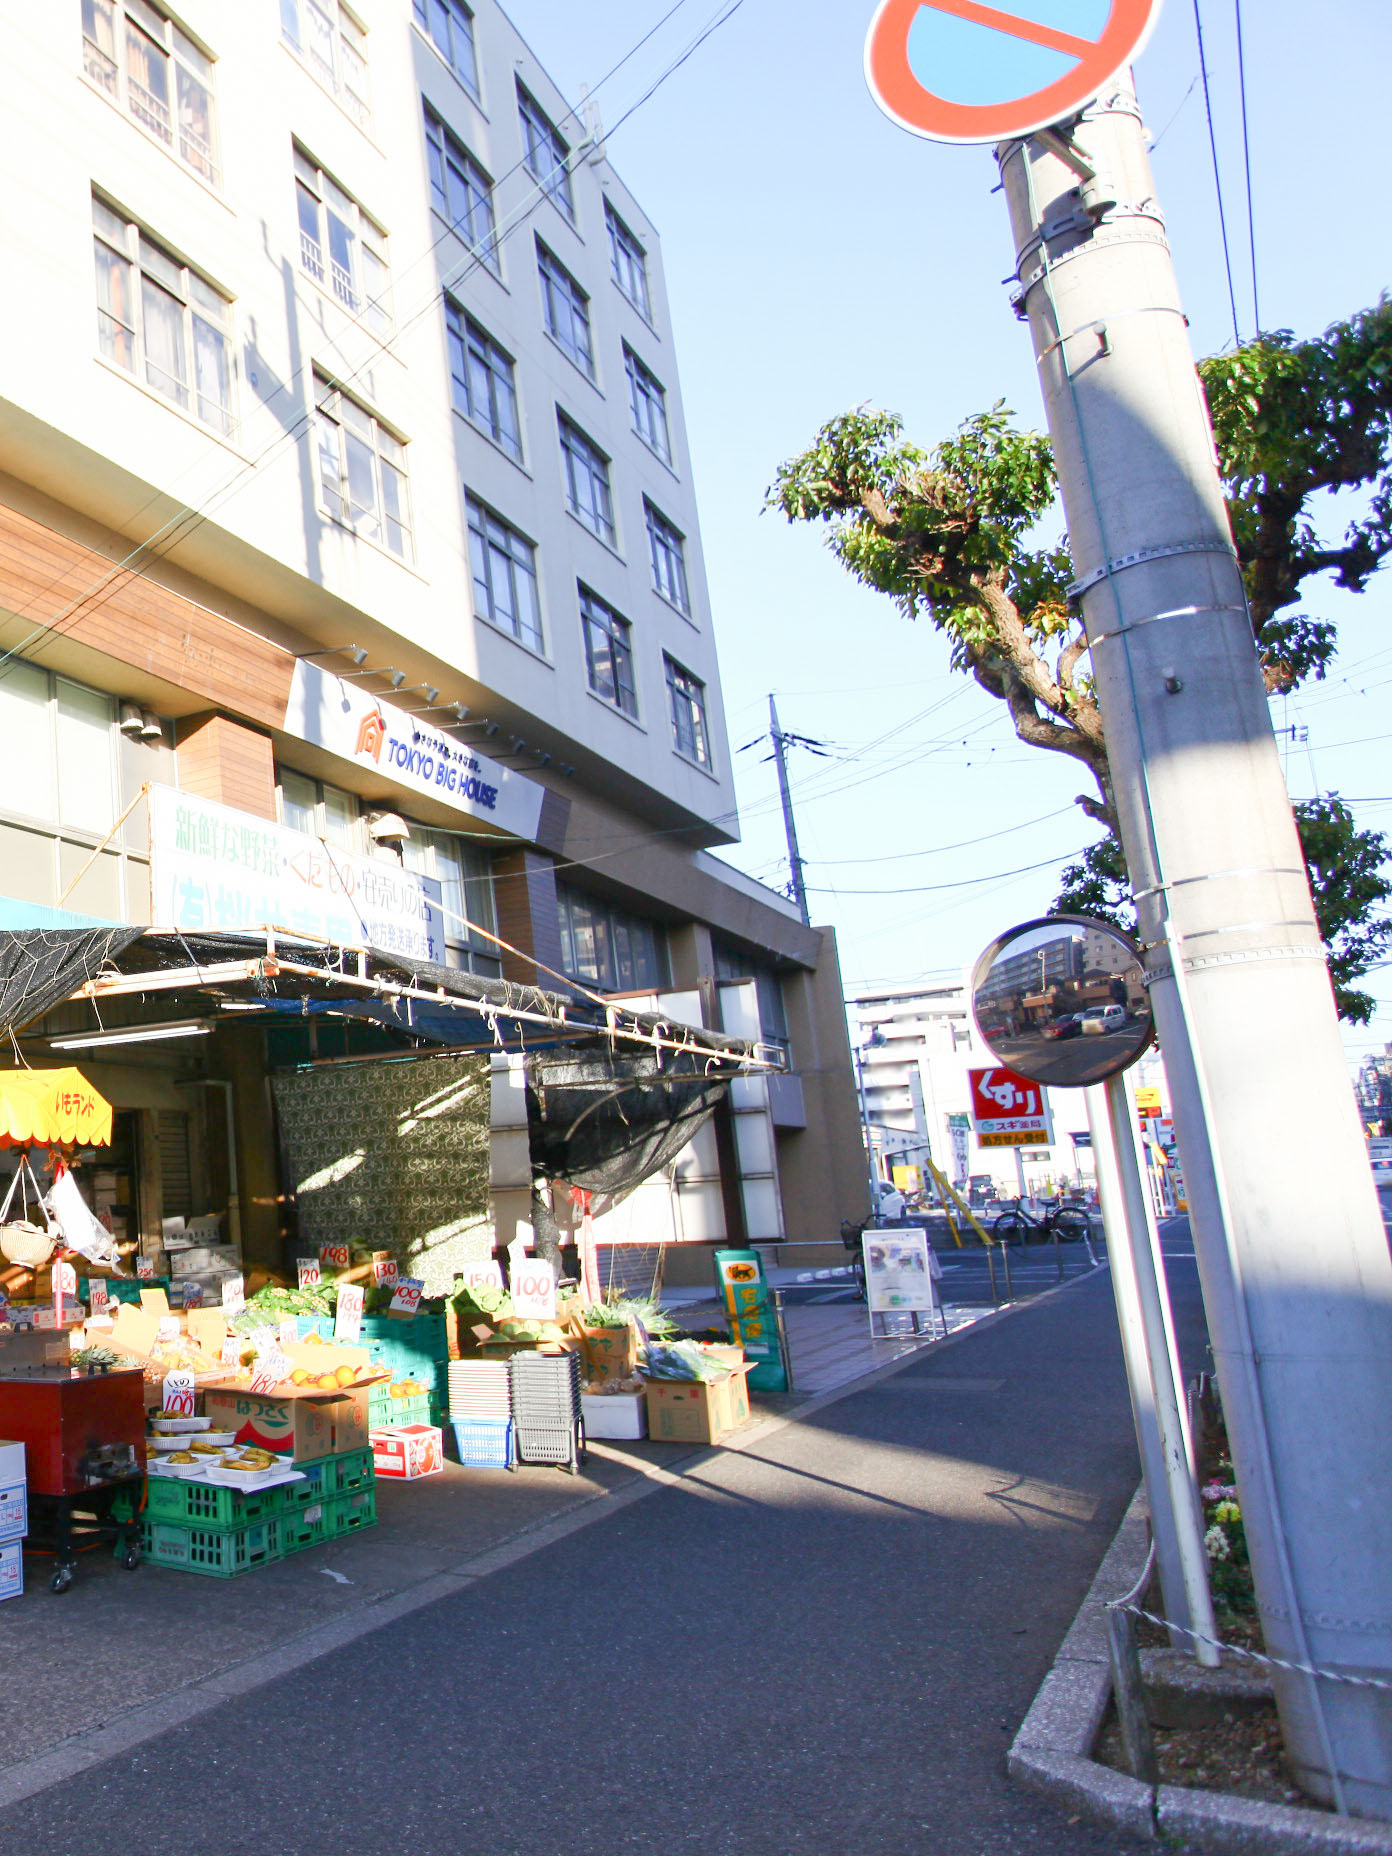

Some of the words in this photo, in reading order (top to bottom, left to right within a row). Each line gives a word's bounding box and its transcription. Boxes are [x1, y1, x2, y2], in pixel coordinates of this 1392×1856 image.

[388, 738, 434, 780] TOKYO
[435, 762, 457, 792] BIG
[457, 772, 499, 810] HOUSE
[978, 1070, 1036, 1114] くすり
[55, 1091, 95, 1118] いもランド
[320, 1246, 349, 1264] 198
[300, 1269, 319, 1285] 120
[375, 1263, 397, 1279] 130
[394, 1286, 421, 1300] 100
[515, 1276, 550, 1297] 100
[339, 1293, 362, 1312] 180
